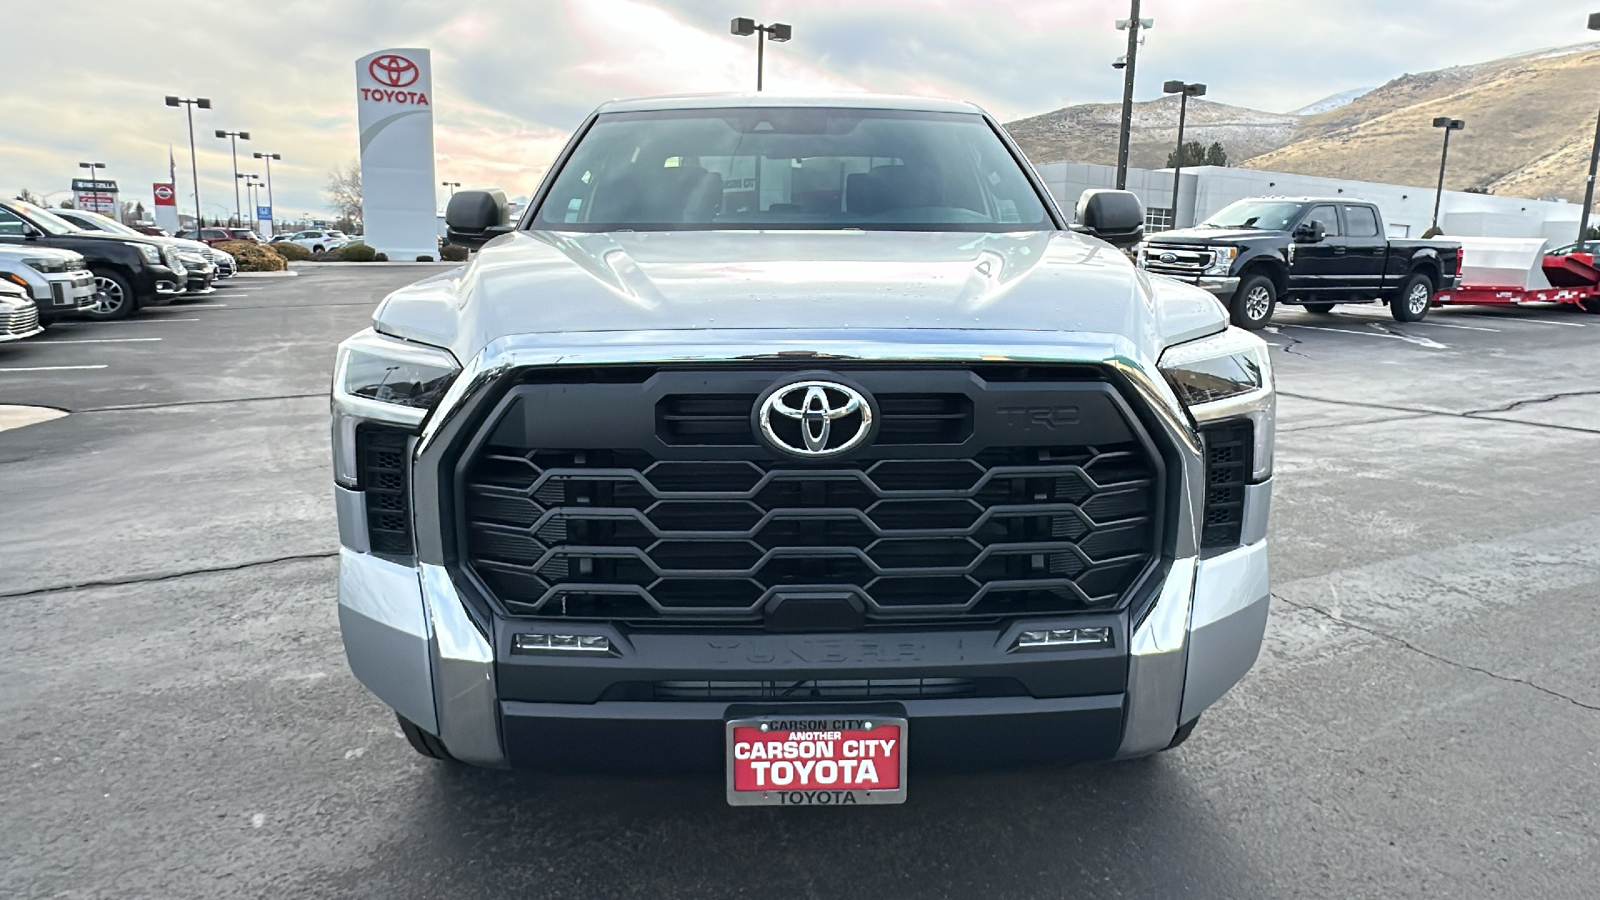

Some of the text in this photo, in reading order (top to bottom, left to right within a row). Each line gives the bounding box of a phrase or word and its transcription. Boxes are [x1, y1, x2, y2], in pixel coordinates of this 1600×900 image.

[361, 88, 429, 105] TOYOTA
[997, 406, 1080, 430] TRD
[770, 719, 864, 731] CARSON CITY
[788, 731, 842, 741] ANOTHER
[734, 739, 896, 760] CARSON CITY
[750, 759, 879, 786] TOYOTA
[777, 790, 857, 804] TOYOTA
